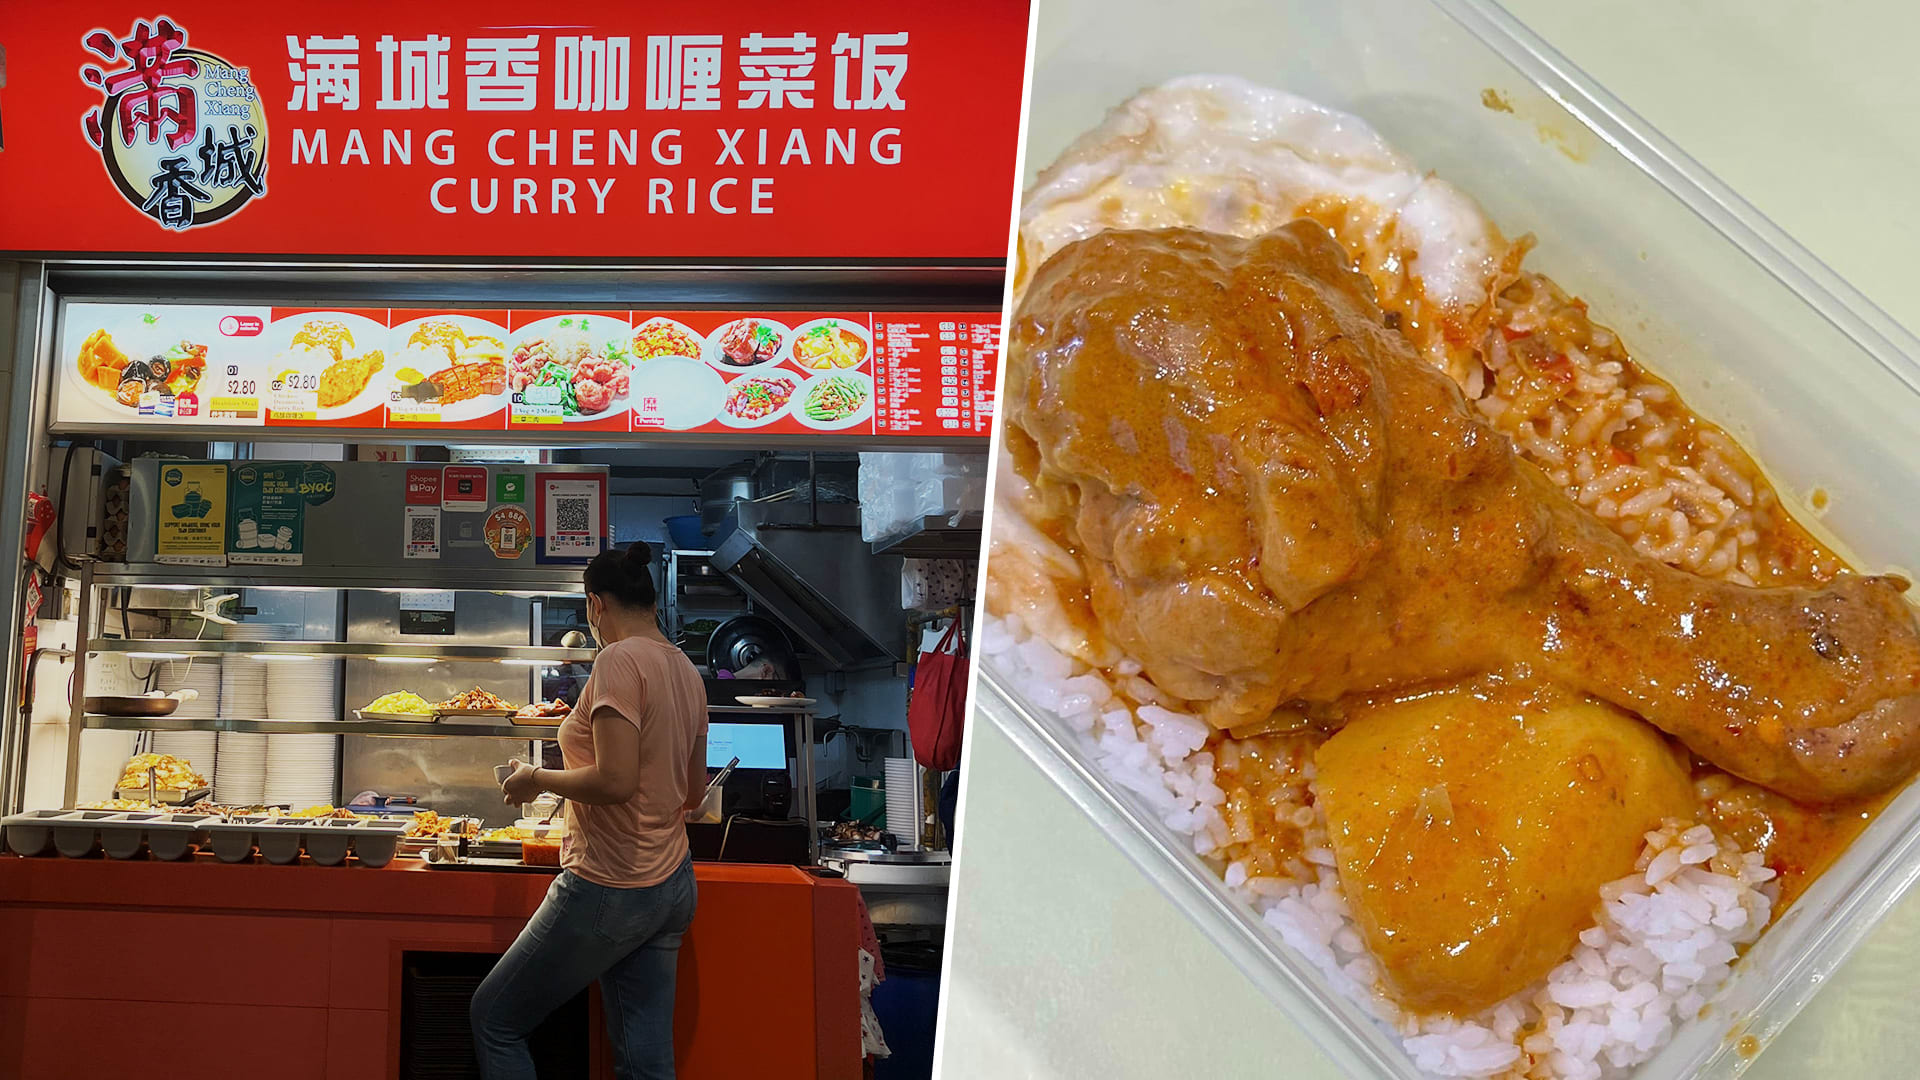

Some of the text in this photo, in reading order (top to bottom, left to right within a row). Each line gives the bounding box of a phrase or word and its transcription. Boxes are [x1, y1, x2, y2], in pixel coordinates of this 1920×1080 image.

[204, 64, 249, 82] Mang
[286, 32, 909, 112] 满城香咖喱菜饭
[204, 82, 255, 101] Cheng
[204, 100, 251, 120] Xiang
[291, 127, 902, 166] MANG CHENG XIANG
[199, 125, 266, 196] 城
[143, 157, 211, 230] 香
[430, 177, 774, 214] CURRY RICE
[227, 380, 256, 395] $2.80
[288, 375, 317, 390] $2.80
[513, 394, 523, 403] 10
[299, 482, 333, 494] BYOC
[410, 474, 437, 484] Shopee
[419, 484, 437, 495] Pay
